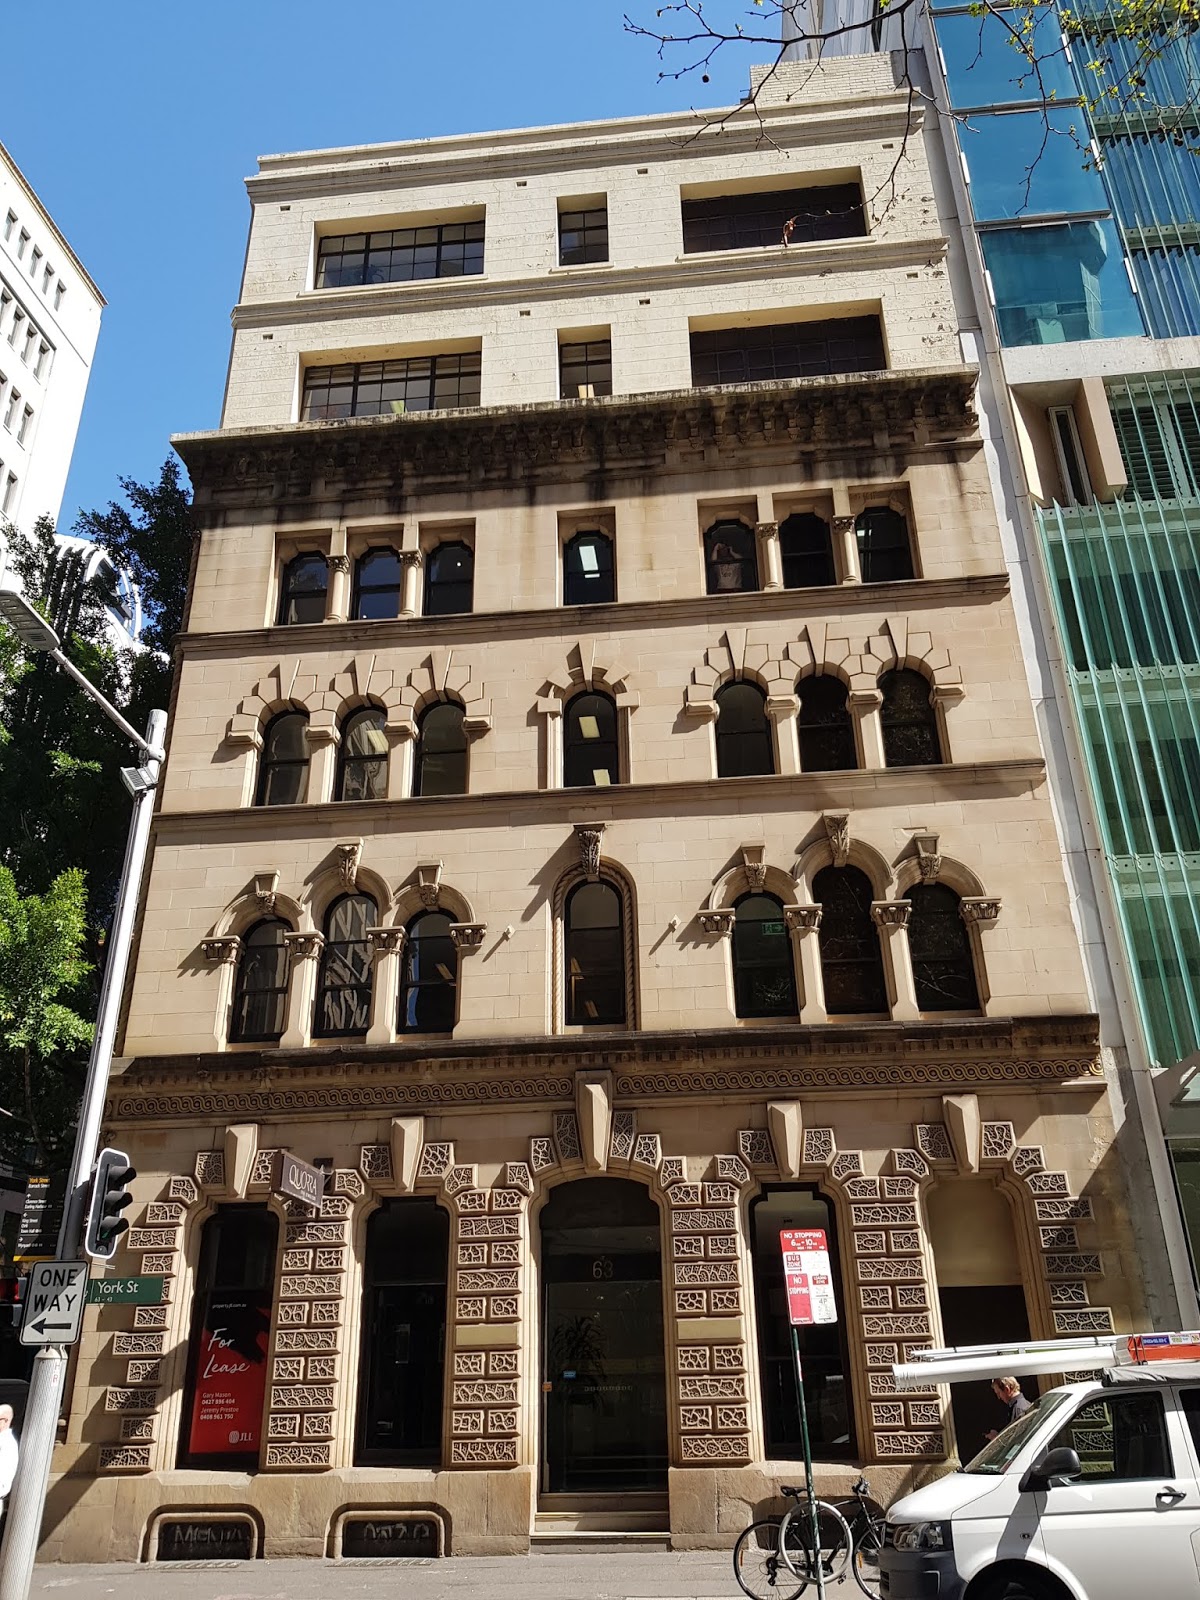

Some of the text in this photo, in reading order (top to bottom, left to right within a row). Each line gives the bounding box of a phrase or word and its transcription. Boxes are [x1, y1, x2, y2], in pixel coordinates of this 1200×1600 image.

[40, 1269, 78, 1287] ONE
[592, 1260, 614, 1279] 63
[97, 1280, 139, 1294] York St
[789, 1287, 810, 1295] STOPPING
[33, 1294, 78, 1312] WAY
[207, 1327, 235, 1352] For
[203, 1354, 250, 1379] Lease
[239, 1432, 253, 1441] JLL
